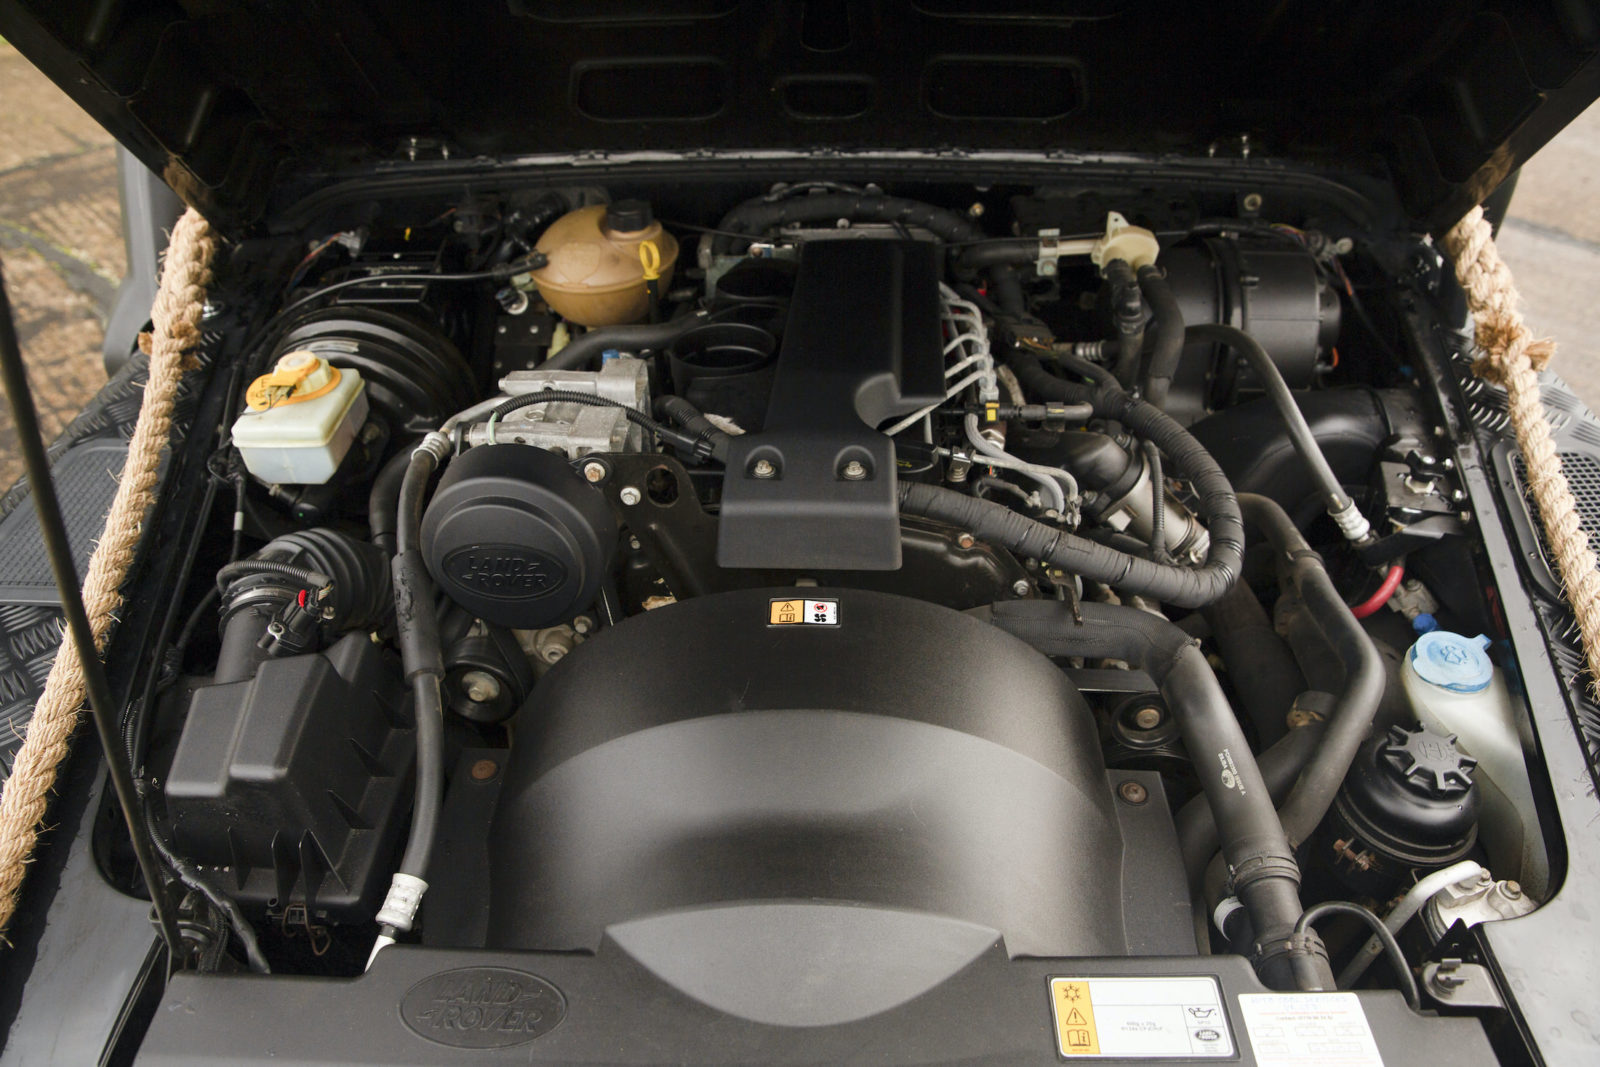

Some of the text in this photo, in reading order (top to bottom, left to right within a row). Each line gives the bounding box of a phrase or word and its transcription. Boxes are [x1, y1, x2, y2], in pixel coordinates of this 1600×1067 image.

[468, 556, 526, 572] LAND
[477, 572, 548, 588] ROVER
[432, 978, 521, 1004] LAND
[432, 1005, 545, 1032] ROVER
